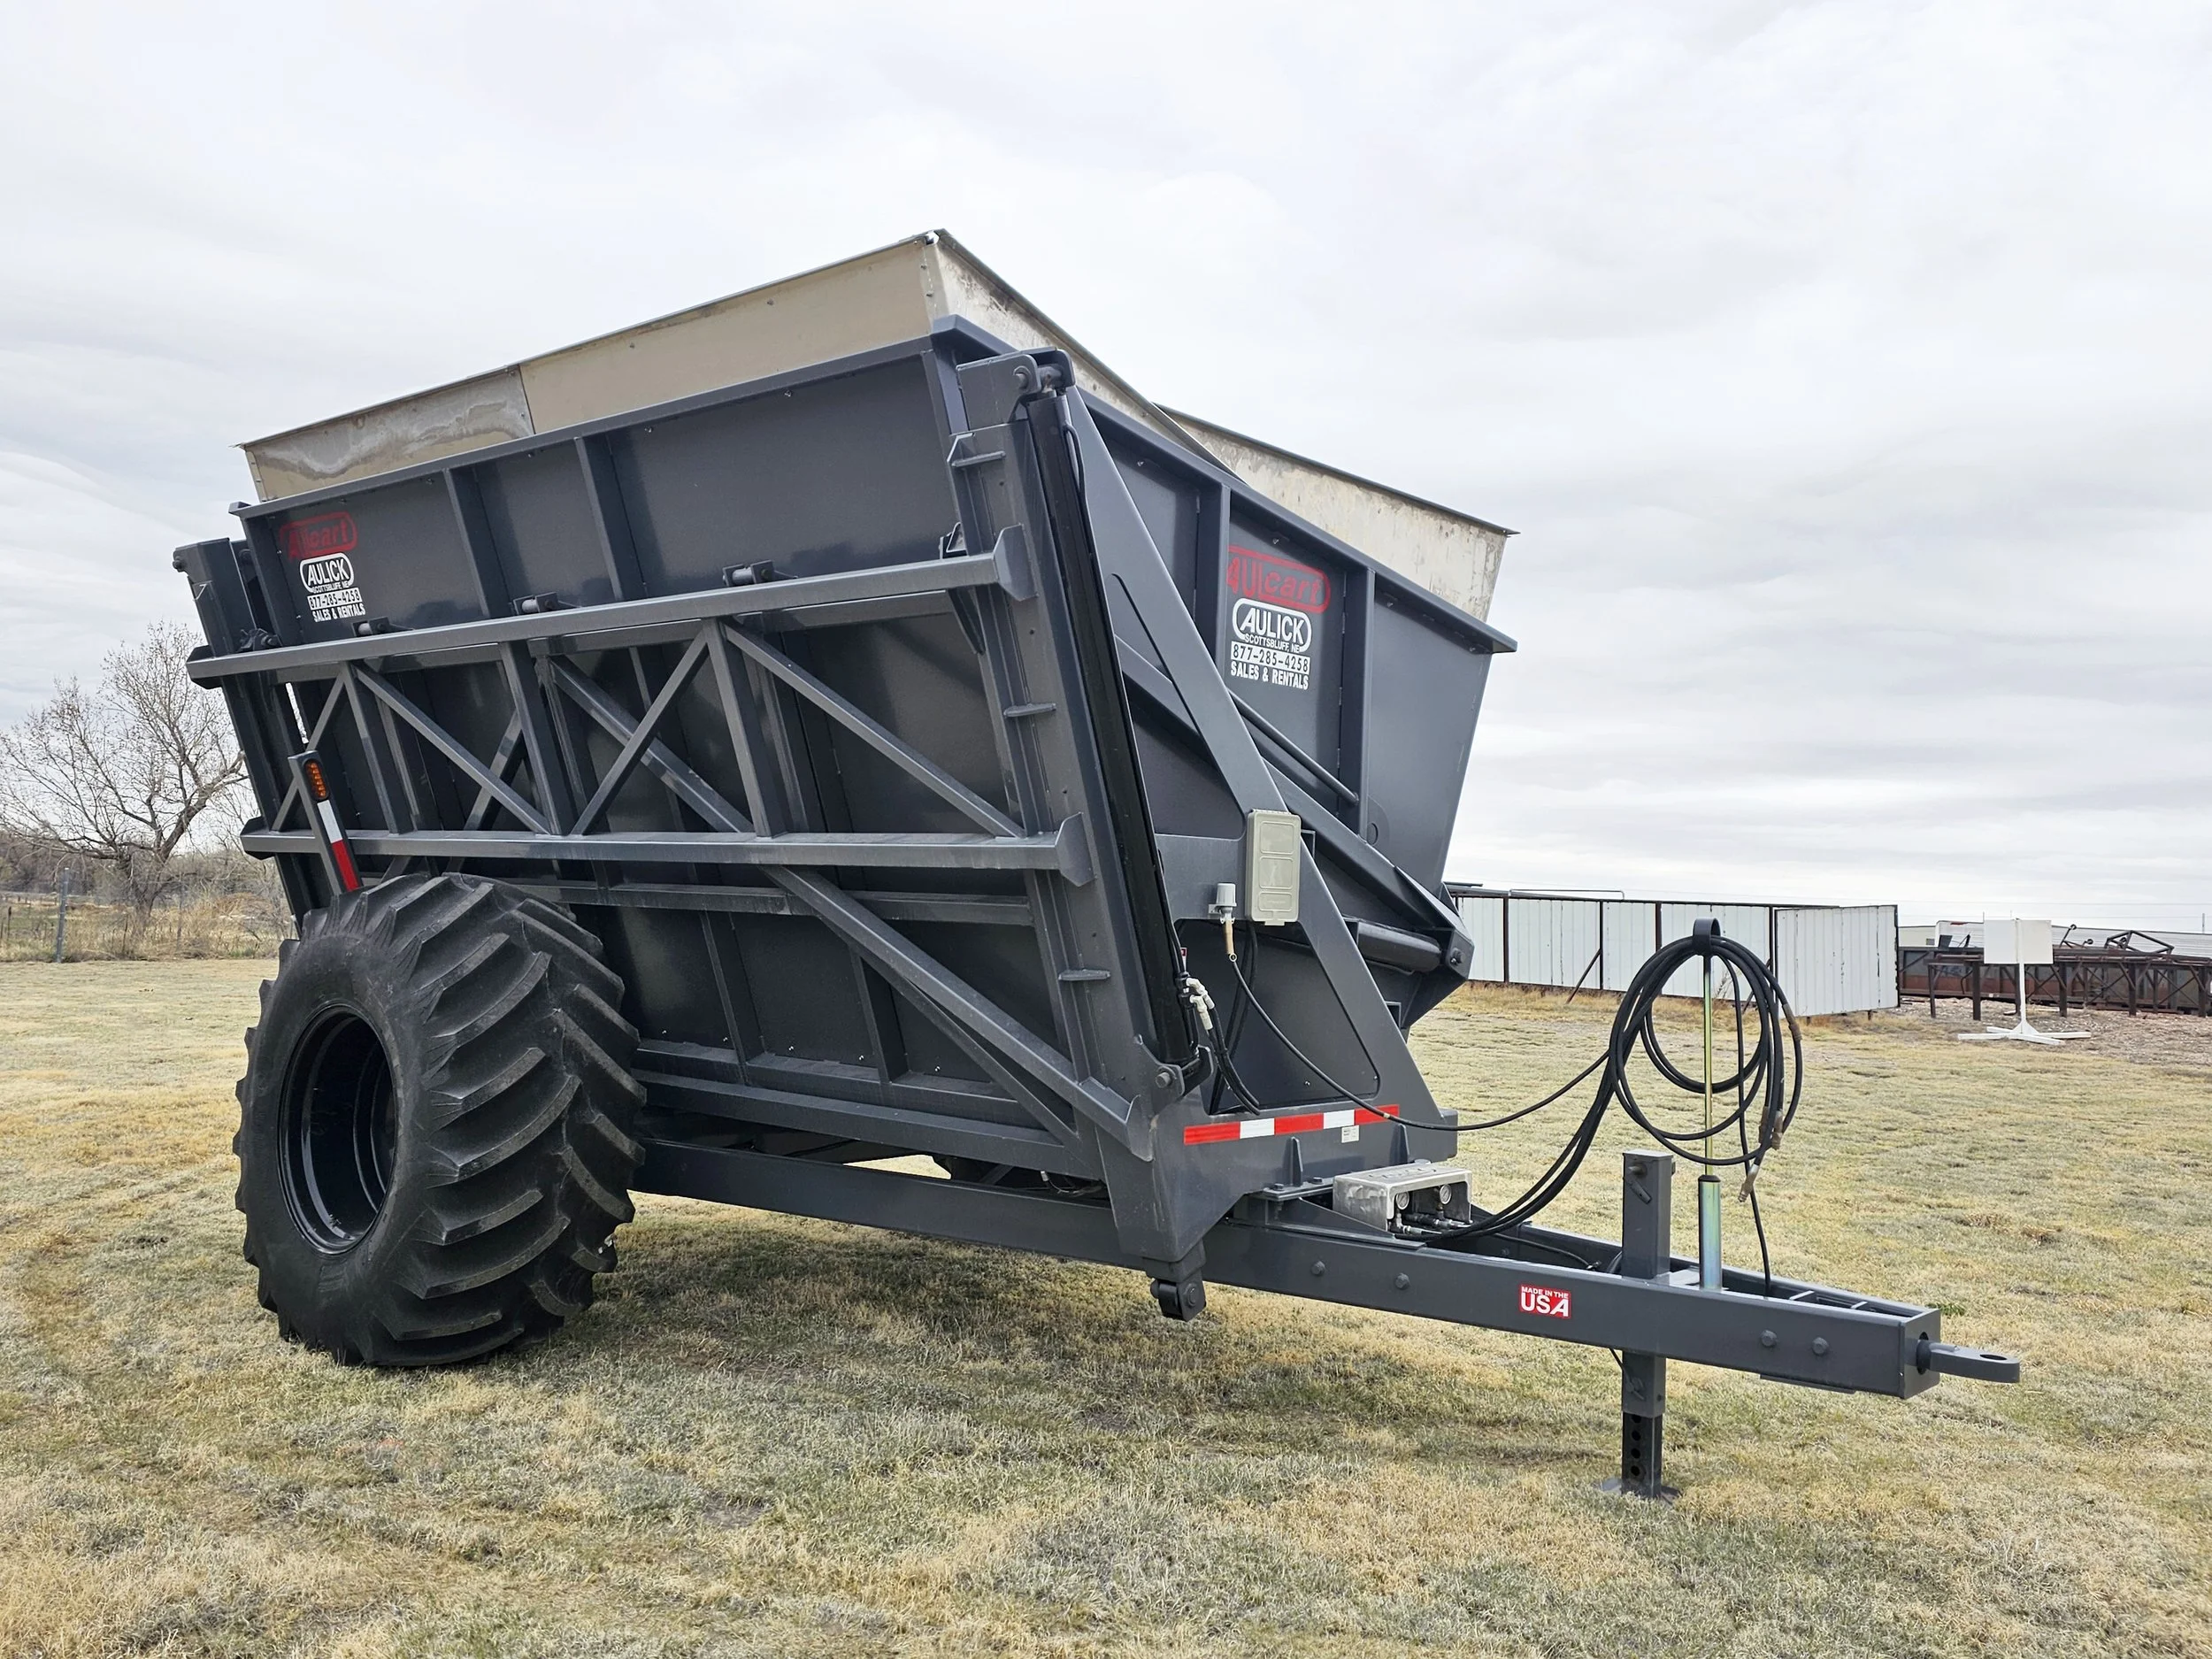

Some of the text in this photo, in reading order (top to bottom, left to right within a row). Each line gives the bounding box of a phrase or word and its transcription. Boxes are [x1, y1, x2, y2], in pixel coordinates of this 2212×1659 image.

[308, 558, 349, 586] AULICK
[309, 588, 361, 609] 877-285-4258
[312, 603, 366, 622] SALES & RENTALS
[1240, 607, 1306, 645] AULICK
[1233, 643, 1309, 672] 877-285-4258
[1291, 643, 1301, 654] NE
[1231, 661, 1310, 690] SALES & RENTALS
[1521, 1286, 1543, 1295] MADE
[1521, 1292, 1569, 1317] USA
